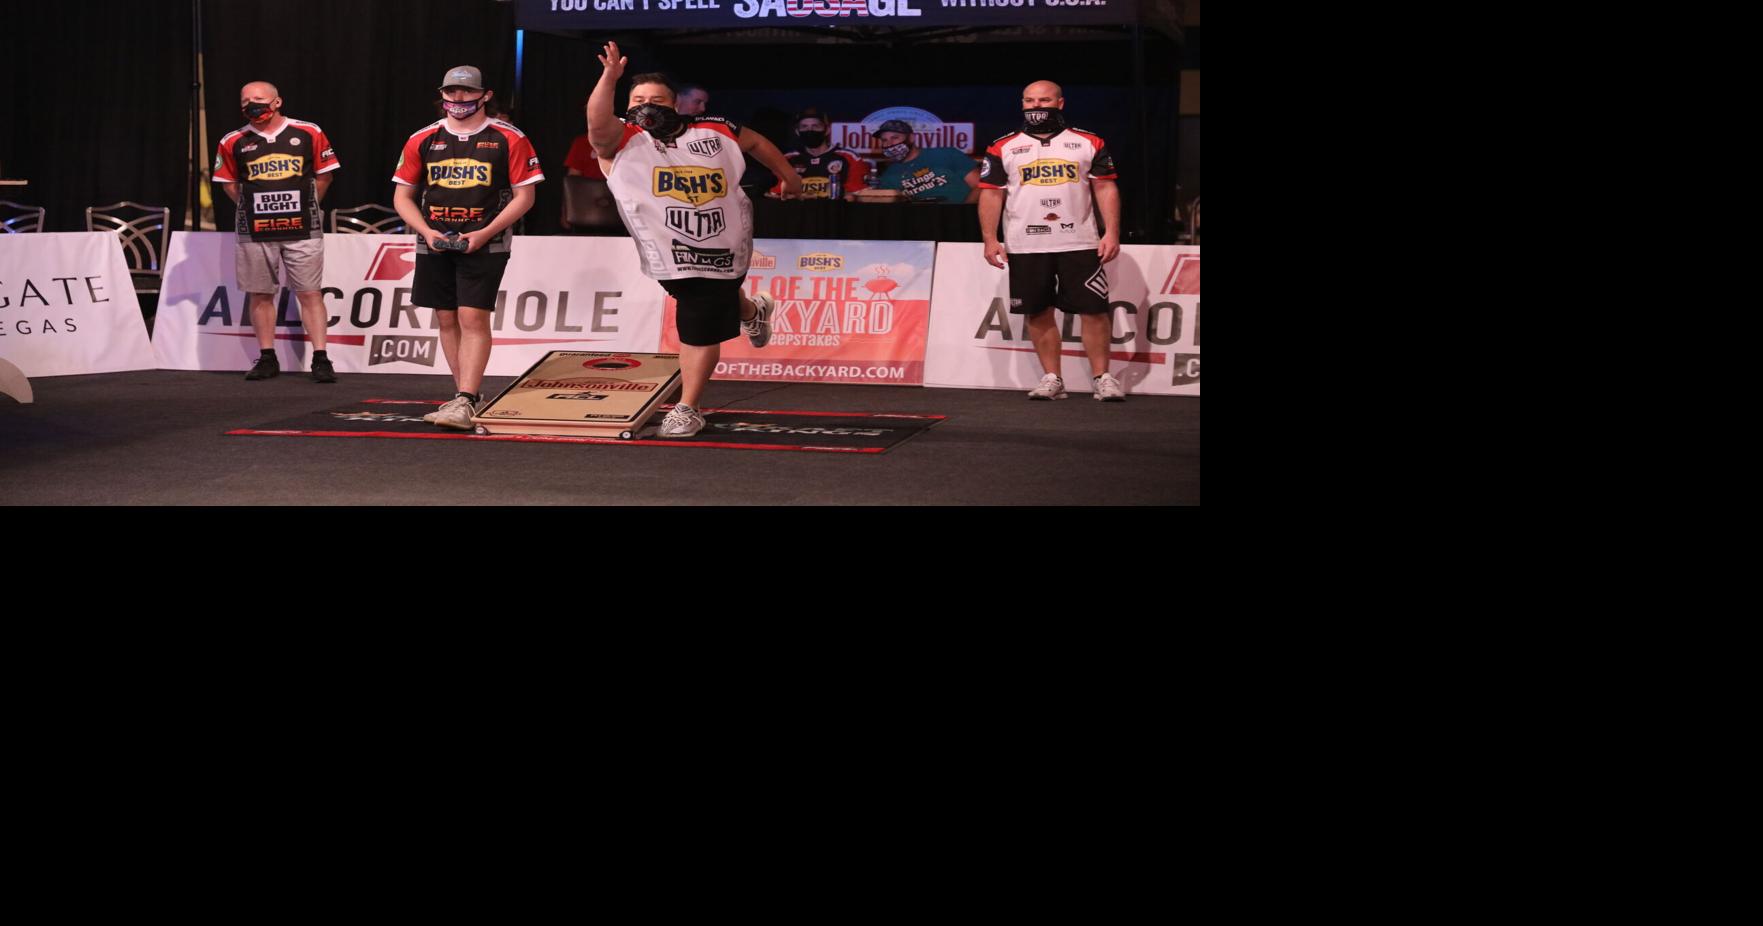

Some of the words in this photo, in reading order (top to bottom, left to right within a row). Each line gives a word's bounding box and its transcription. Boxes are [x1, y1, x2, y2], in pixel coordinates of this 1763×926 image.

[551, 0, 588, 11] YOU
[594, 0, 649, 10] CANT
[733, 0, 922, 18] SAUSAGE
[690, 137, 721, 155] ULTRA
[842, 125, 968, 149] Johnville
[251, 158, 301, 177] BUSH'S
[430, 165, 488, 182] BUSH'S
[1022, 164, 1076, 182] BUSH'S
[256, 202, 298, 212] LIGHT
[261, 194, 293, 202] BUD
[429, 205, 484, 220] FIRE
[254, 217, 302, 232] FIRE
[800, 257, 841, 268] BUSH'S
[769, 276, 800, 300] OF
[810, 276, 860, 300] THE
[771, 300, 893, 334] KYARD
[373, 339, 431, 359] .COM
